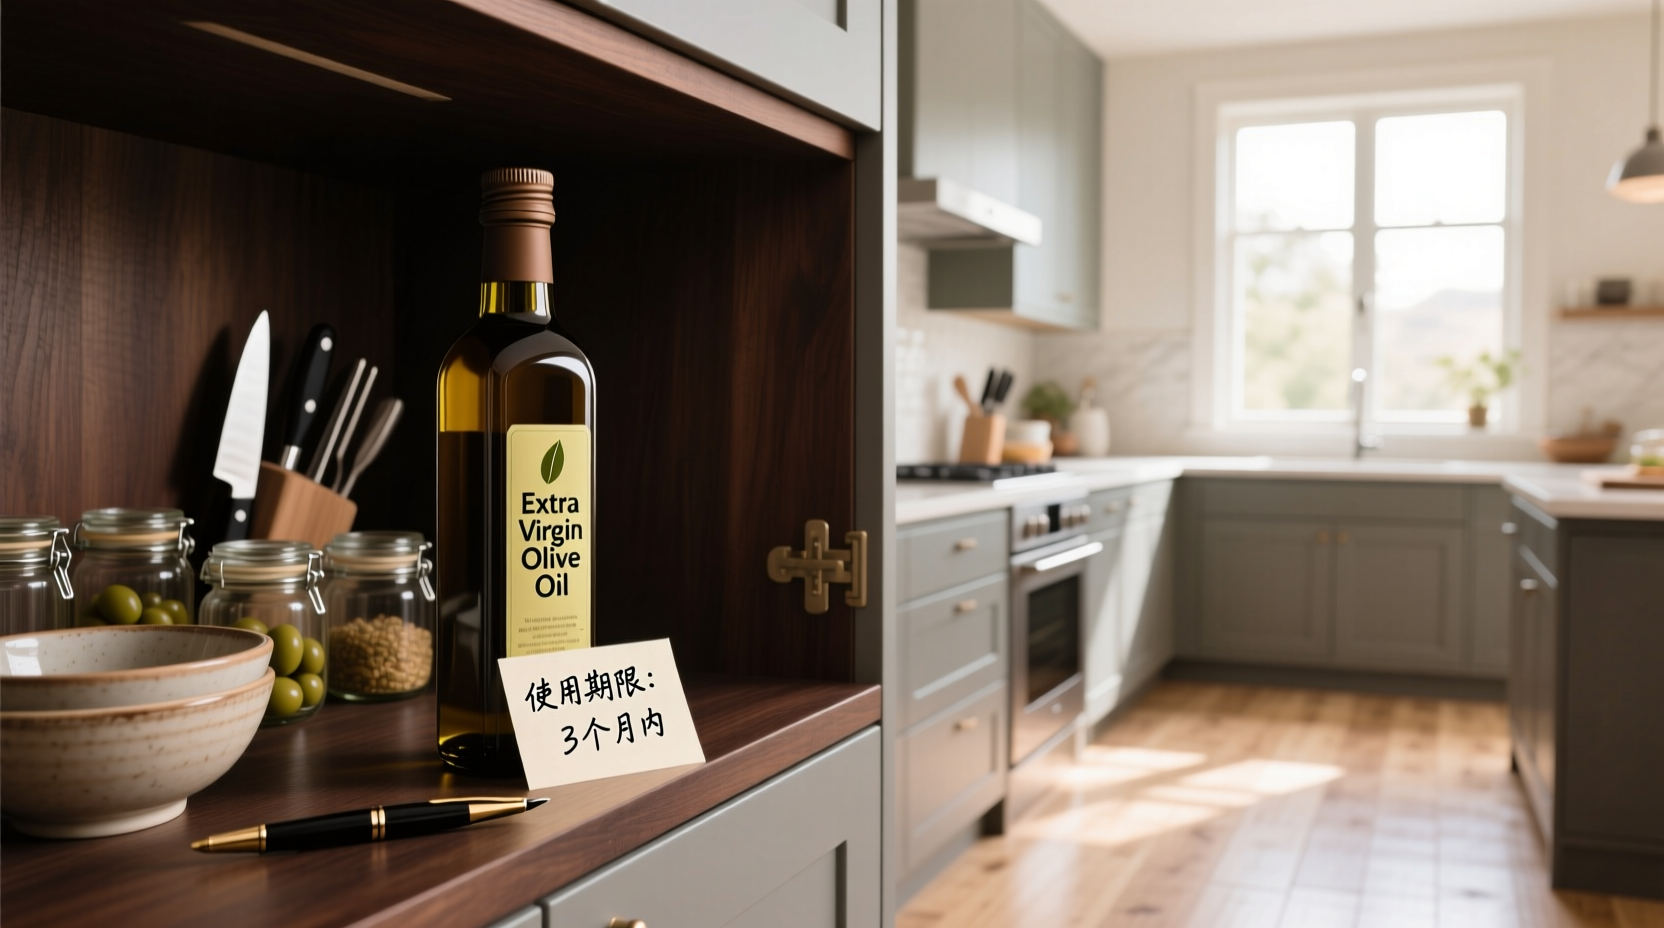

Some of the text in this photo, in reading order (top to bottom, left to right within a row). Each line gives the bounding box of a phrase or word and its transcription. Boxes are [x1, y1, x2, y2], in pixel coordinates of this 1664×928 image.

[521, 492, 579, 515] Extra
[518, 518, 583, 548] Virgin
[521, 546, 581, 570] Olive
[535, 572, 569, 598] Oil
[524, 665, 656, 713] 使用期限：
[560, 707, 665, 756] 3个月内
